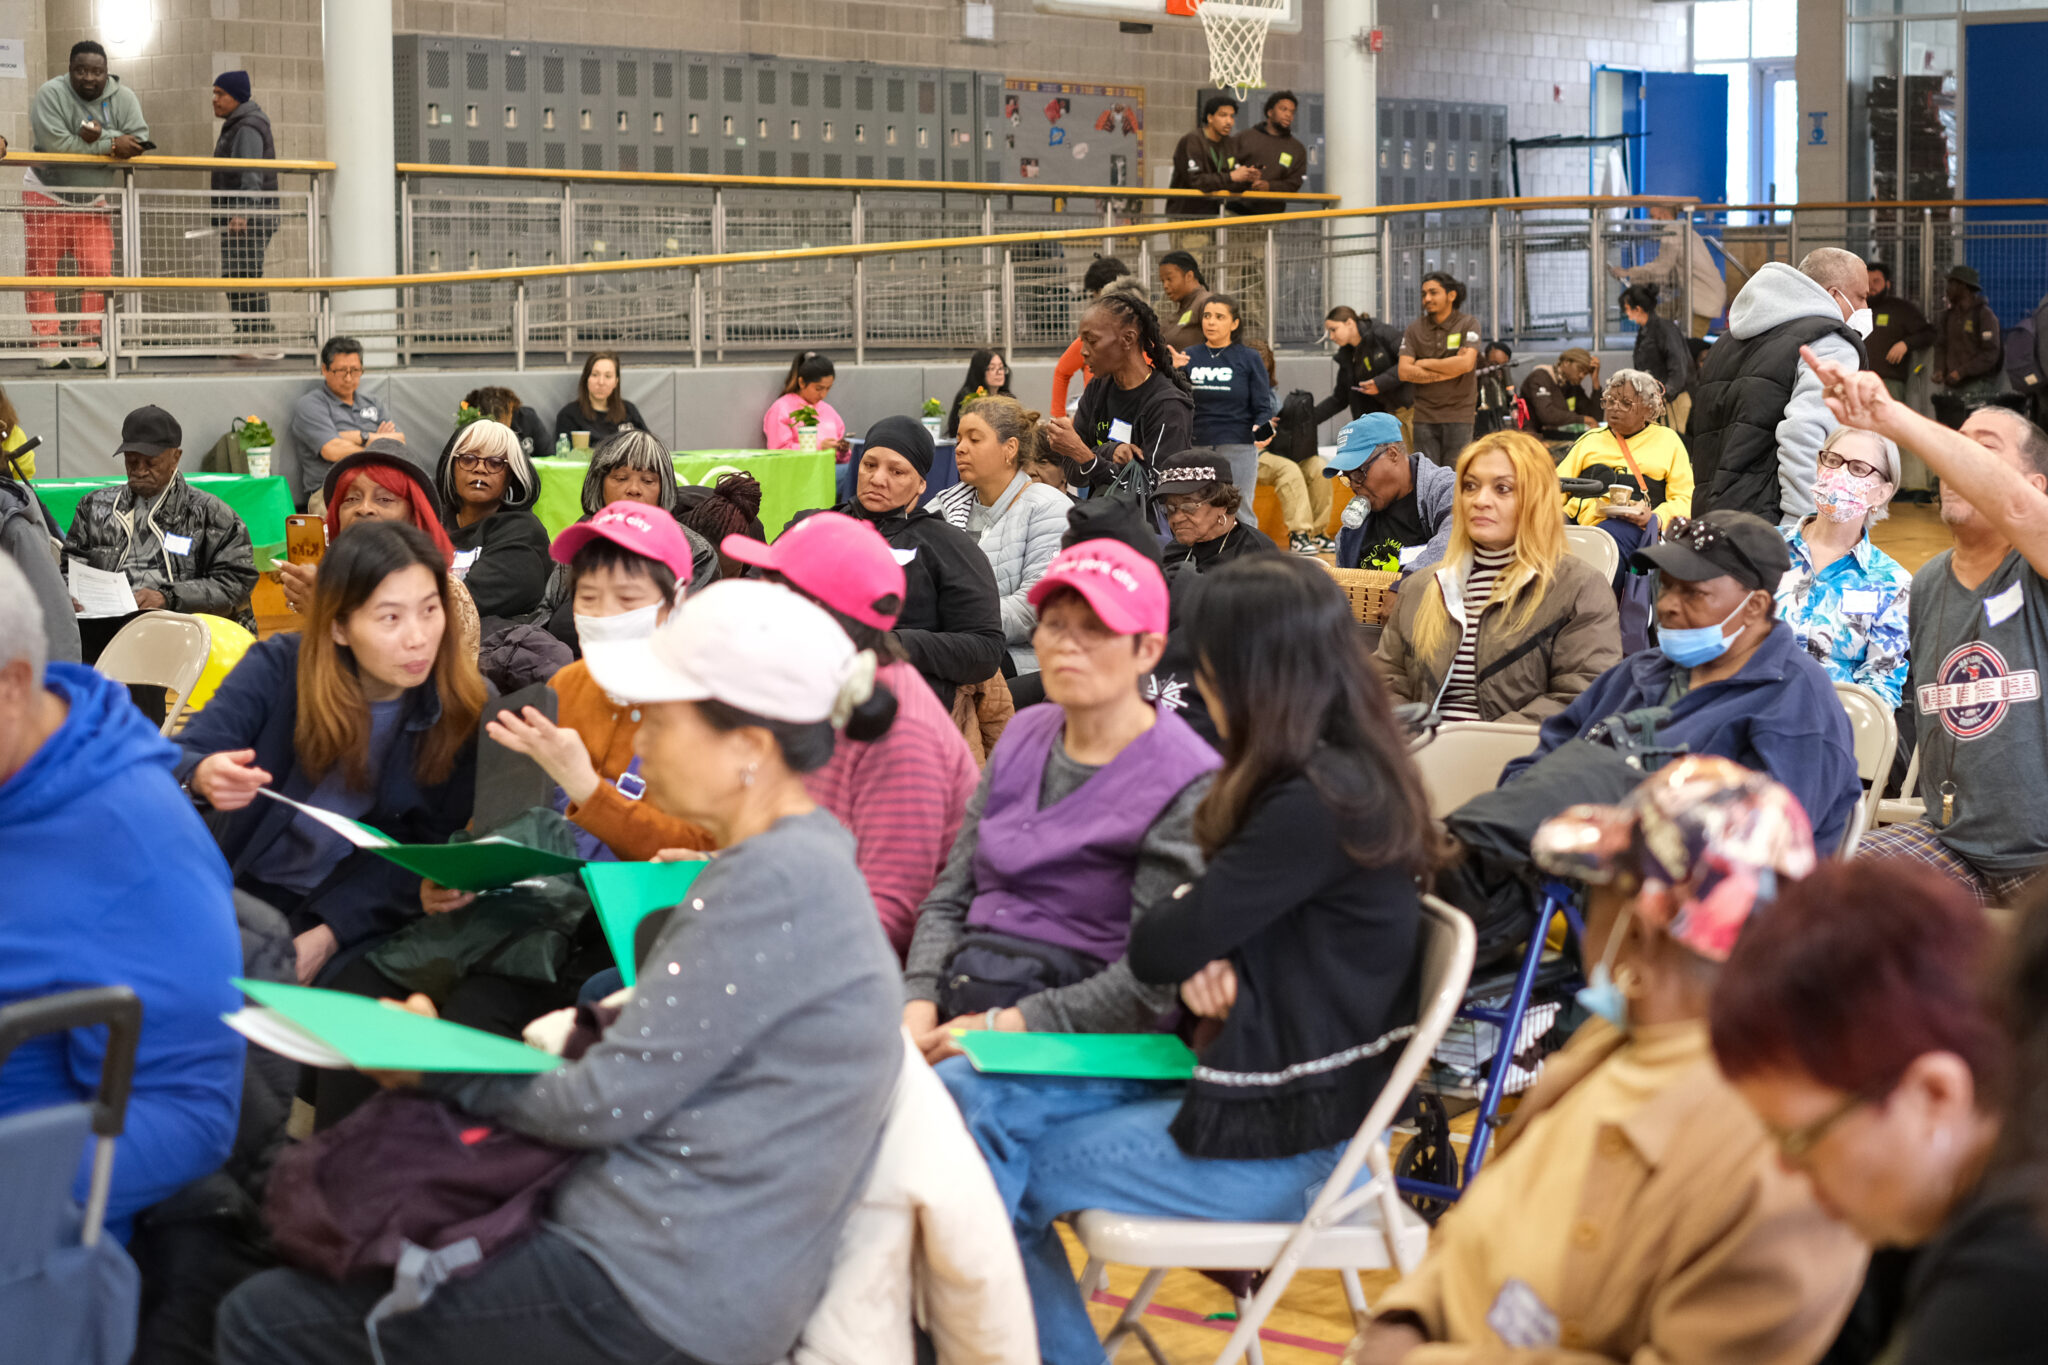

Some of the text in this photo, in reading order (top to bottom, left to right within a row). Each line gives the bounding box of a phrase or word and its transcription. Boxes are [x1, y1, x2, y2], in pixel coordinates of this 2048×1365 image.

[1190, 366, 1233, 381] NYC
[626, 517, 652, 532] city
[1360, 544, 1382, 569] SOUT
[2001, 676, 2033, 697] USA
